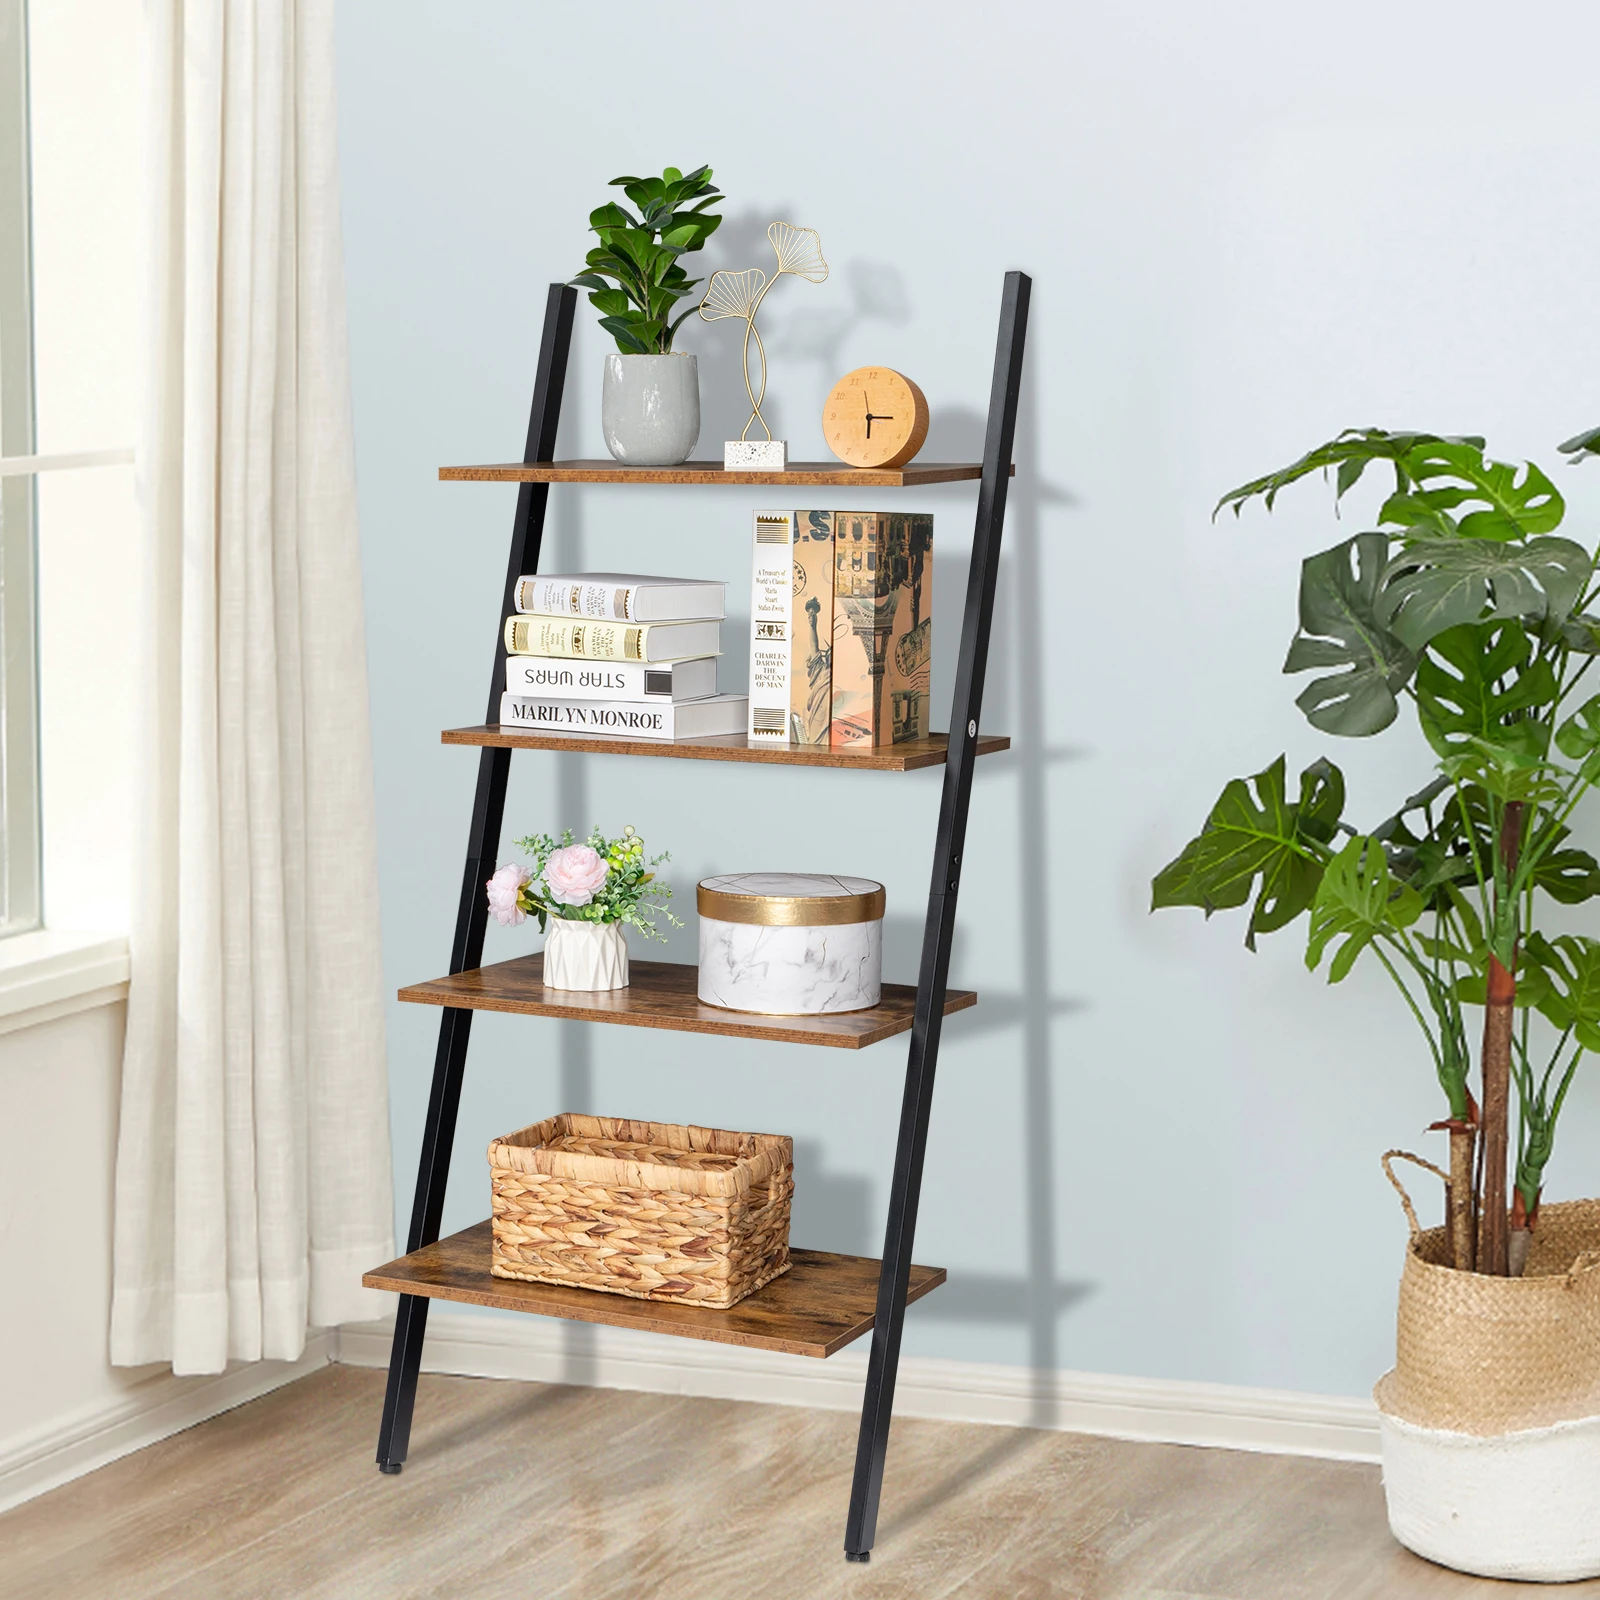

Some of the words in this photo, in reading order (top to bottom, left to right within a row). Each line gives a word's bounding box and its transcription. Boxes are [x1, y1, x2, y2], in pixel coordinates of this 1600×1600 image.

[868, 372, 878, 380] 12
[830, 412, 836, 420] 9
[762, 569, 780, 577] Treasury
[525, 669, 573, 686] WARS
[579, 672, 625, 688] STAR
[512, 704, 587, 724] MARILYN
[590, 710, 662, 729] MONROE
